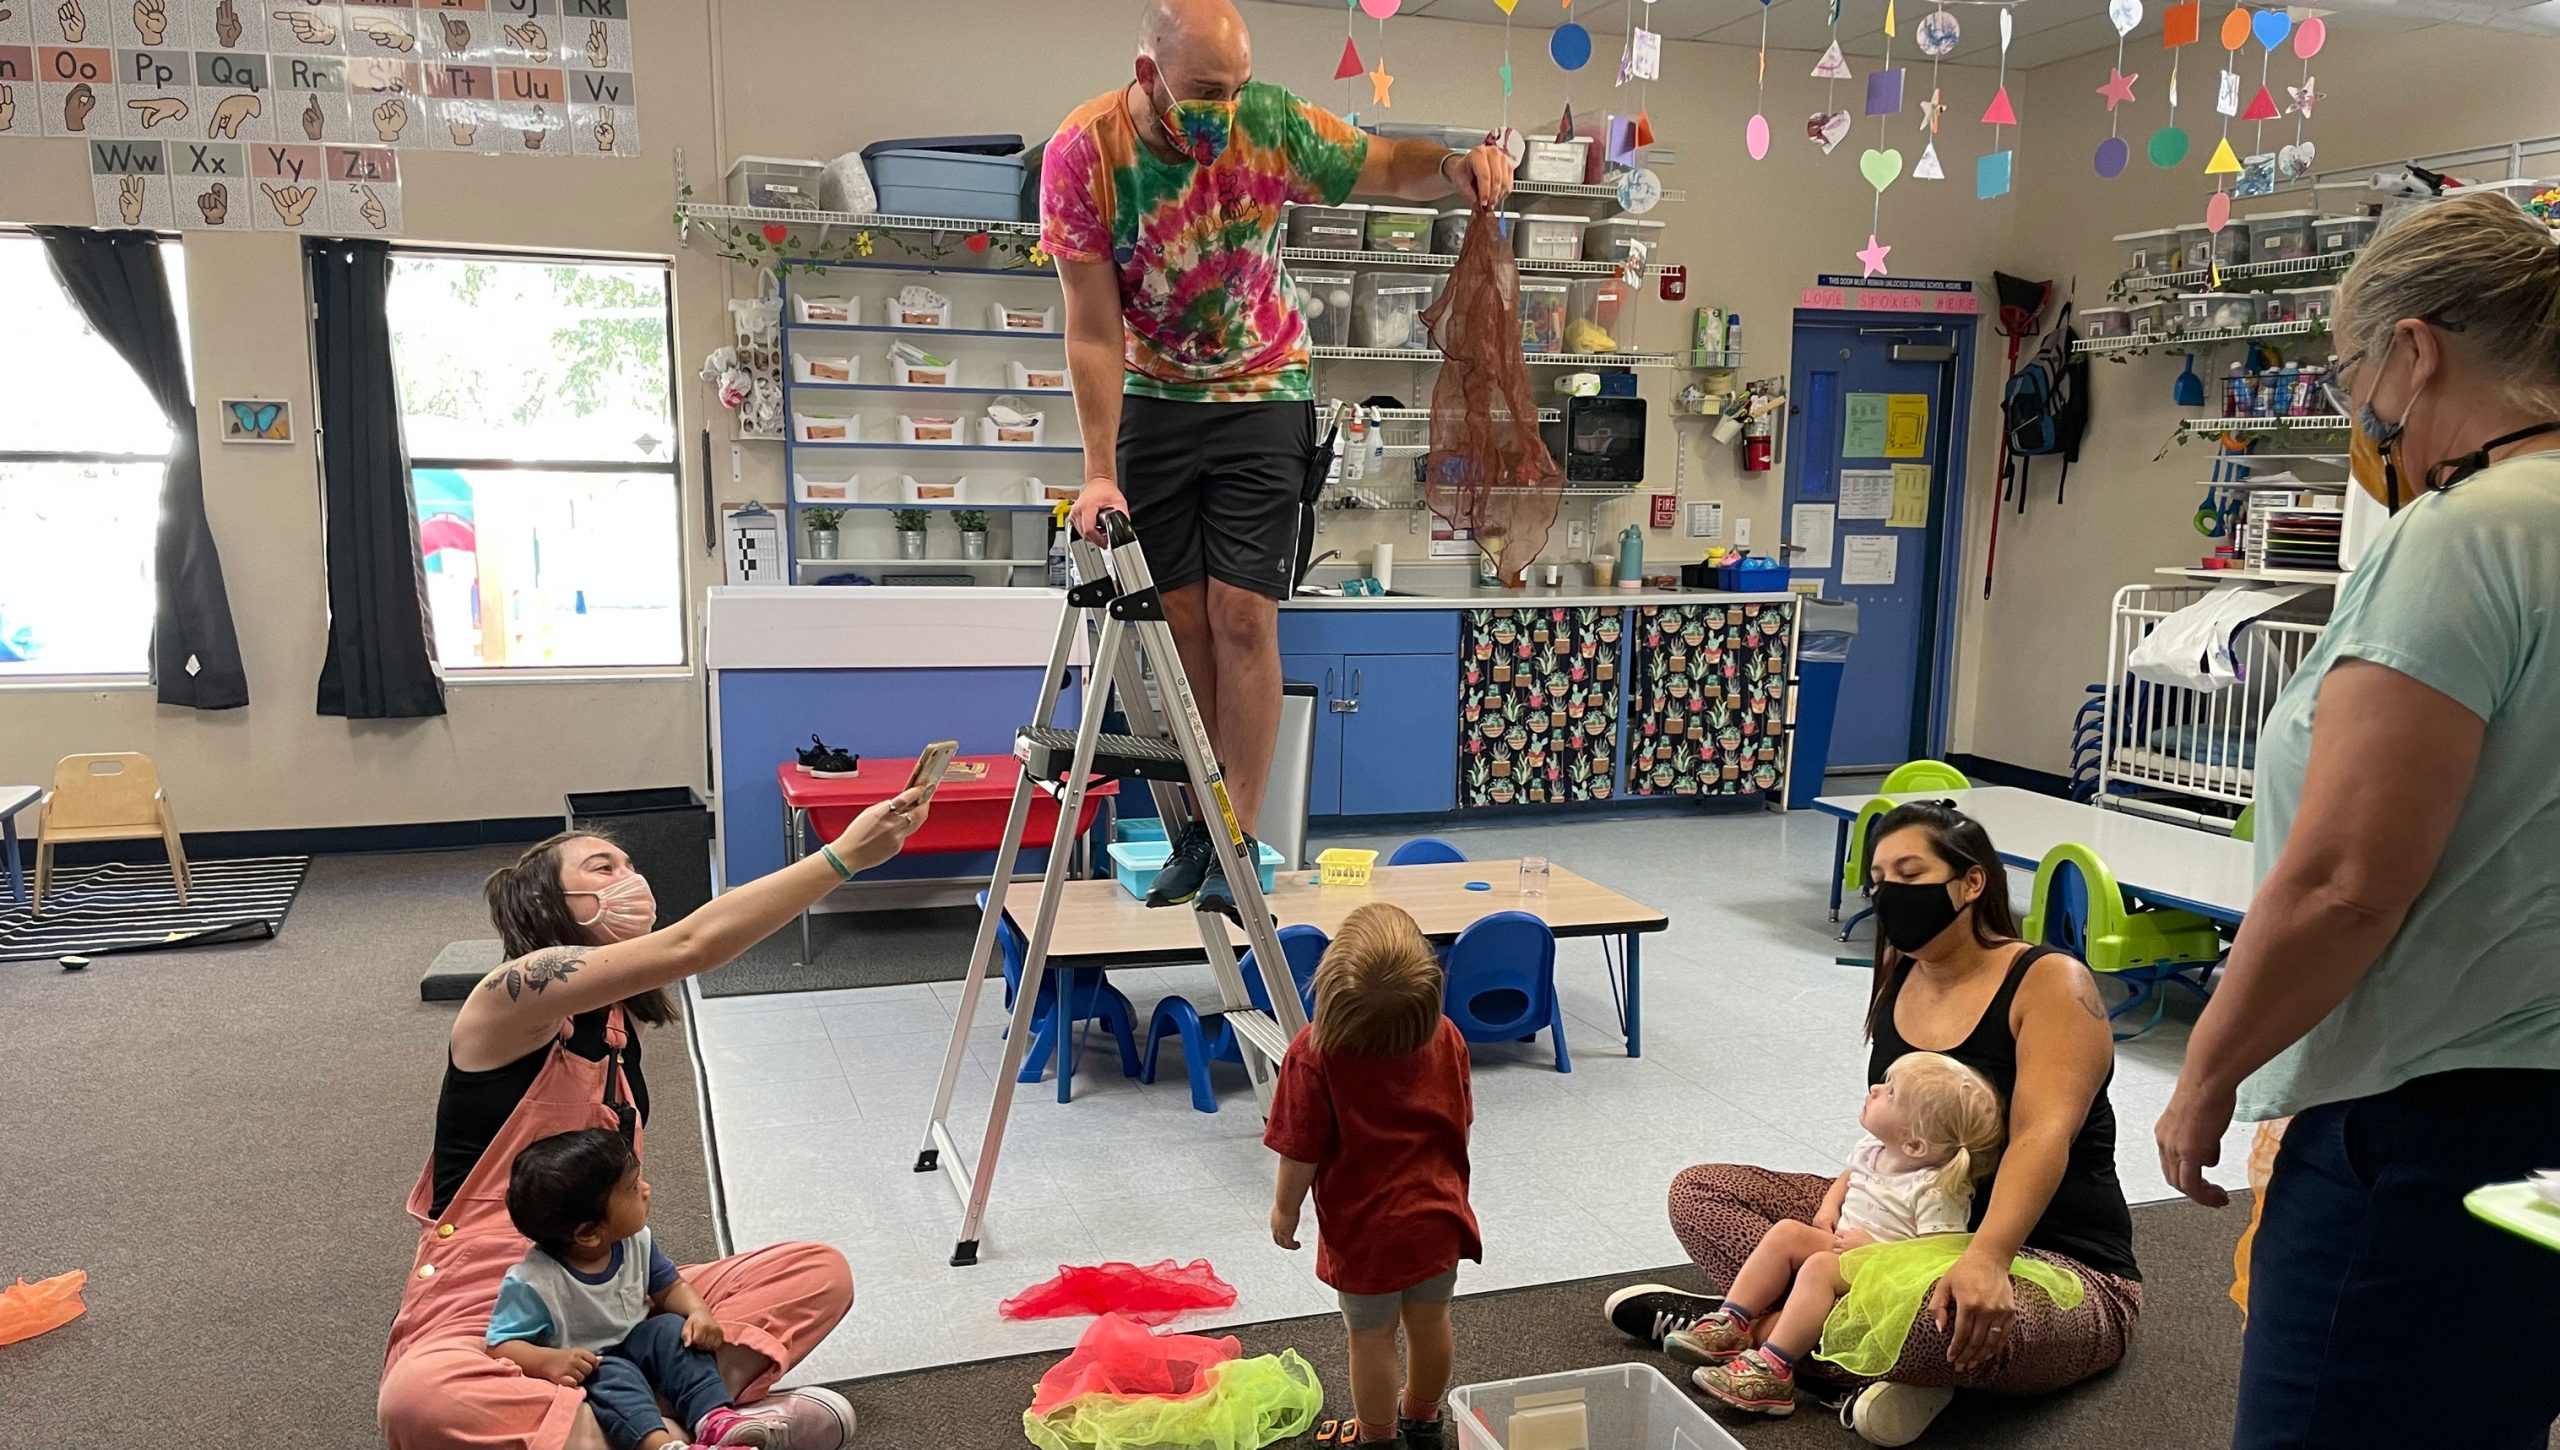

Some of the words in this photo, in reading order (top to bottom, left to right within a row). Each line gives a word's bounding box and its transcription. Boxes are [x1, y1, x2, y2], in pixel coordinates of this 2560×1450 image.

[55, 51, 97, 79] Oo
[136, 53, 173, 89] Pp
[211, 56, 259, 92] Qq
[292, 59, 327, 88] Rr
[368, 64, 403, 92] Ss
[446, 68, 475, 97] Tt
[512, 70, 548, 100] Uu
[585, 74, 618, 101] Vv
[97, 143, 157, 172] Ww
[190, 145, 226, 174] Xx
[268, 147, 303, 183] Yy
[341, 150, 381, 180] Zz
[1803, 290, 1842, 306] LOVE
[1859, 292, 1921, 308] SPOKEN
[1936, 295, 1977, 311] HERE
[1657, 498, 1675, 511] FIRE
